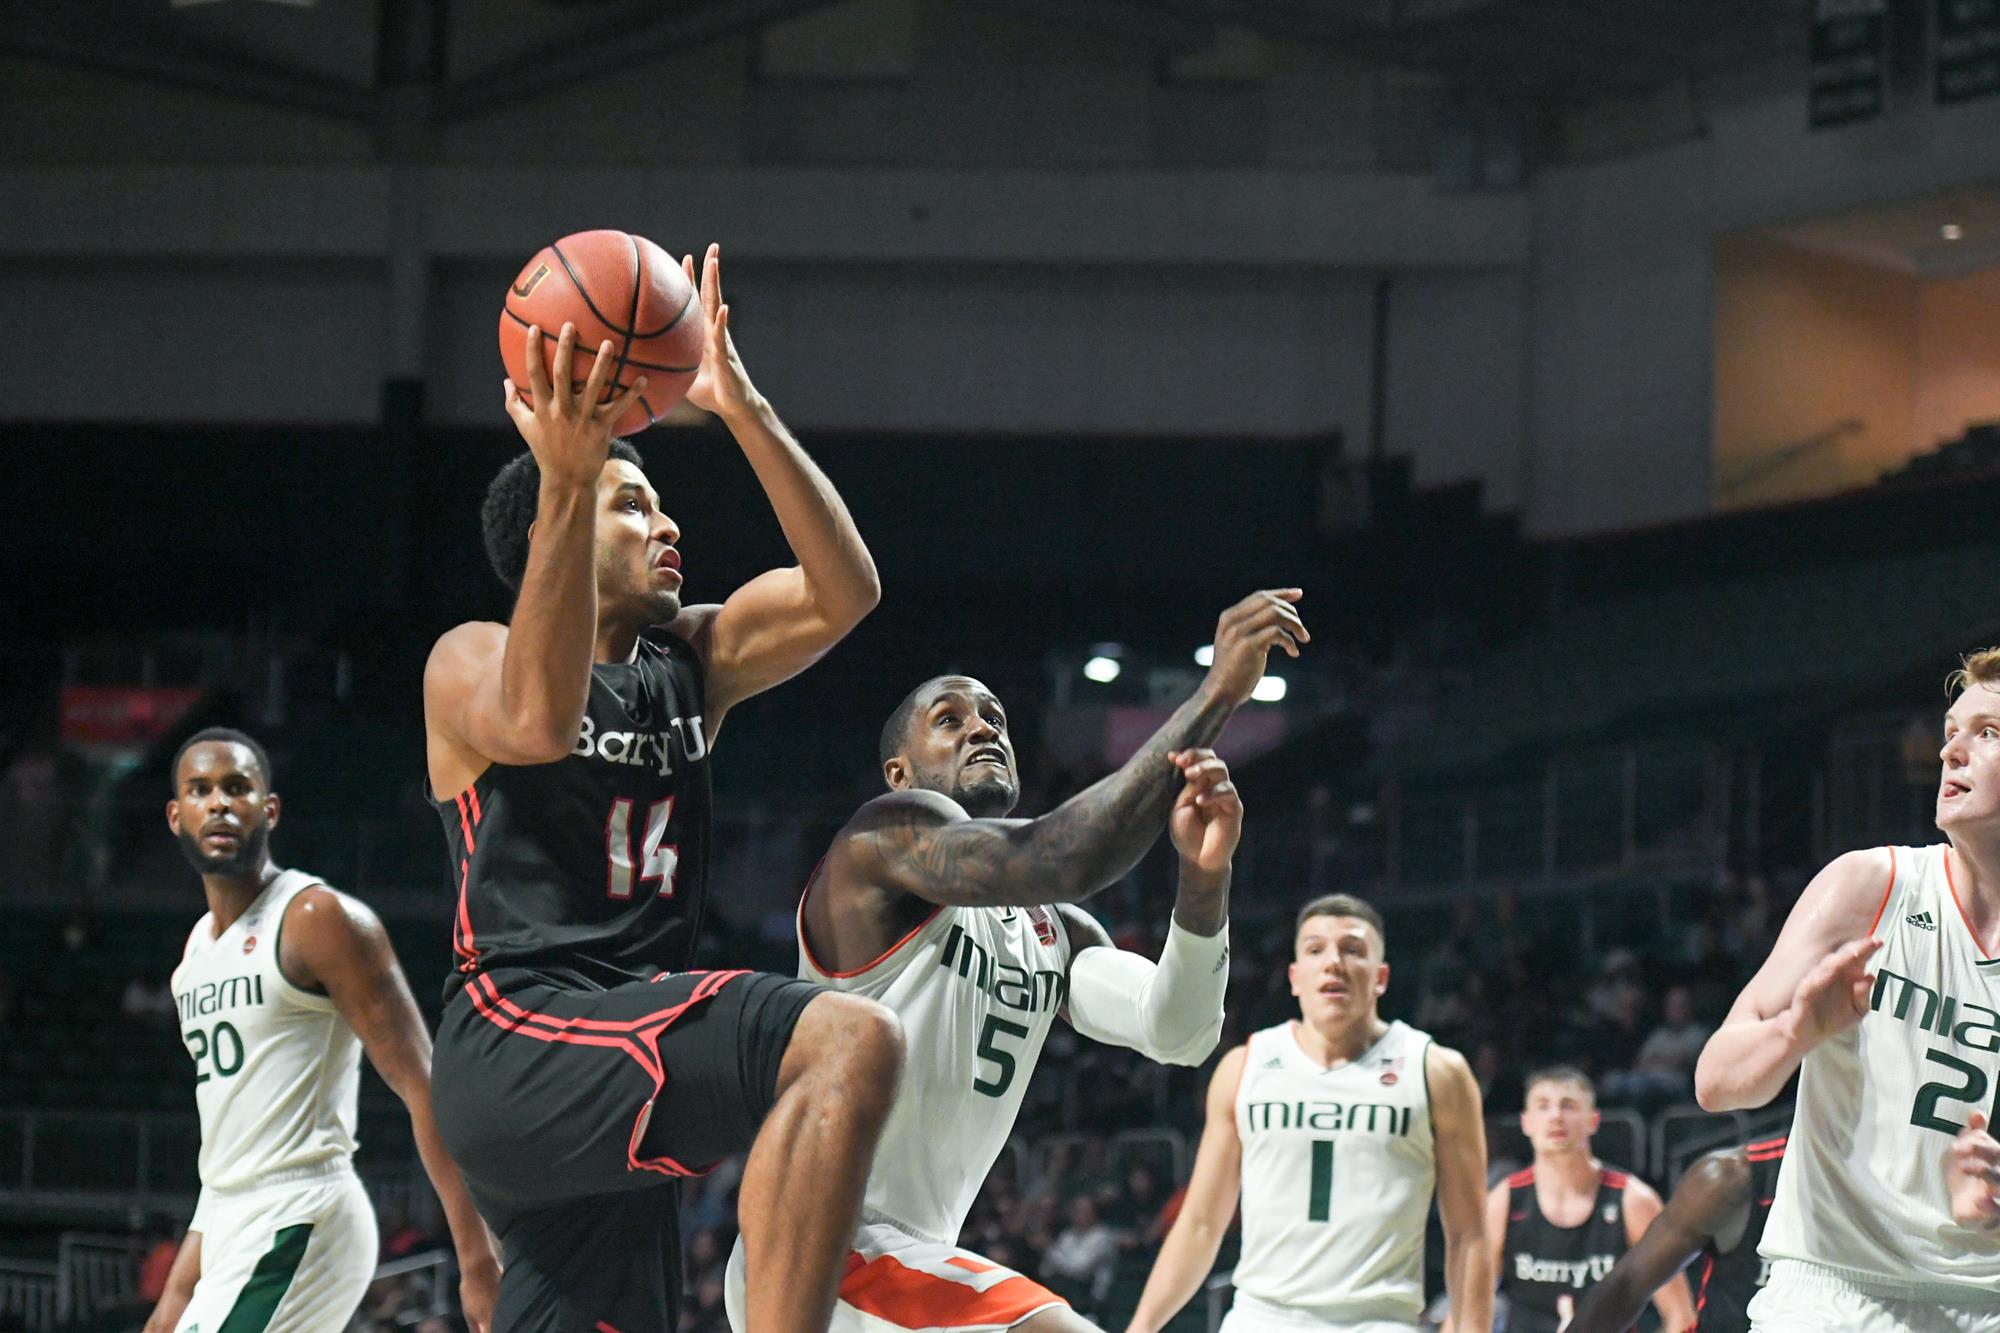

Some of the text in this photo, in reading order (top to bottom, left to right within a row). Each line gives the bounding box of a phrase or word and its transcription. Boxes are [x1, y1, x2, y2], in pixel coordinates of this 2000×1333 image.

[571, 715, 706, 776] Bary U
[607, 796, 678, 898] 14
[1905, 917, 1937, 932] adidas
[178, 975, 264, 1024] MIAMI
[940, 924, 1065, 1014] MIAM
[1871, 968, 2000, 1053] MIA
[185, 1021, 245, 1084] 20
[973, 1013, 1029, 1098] 5
[1249, 1102, 1411, 1137] MIAMI
[1308, 1140, 1334, 1222] 1
